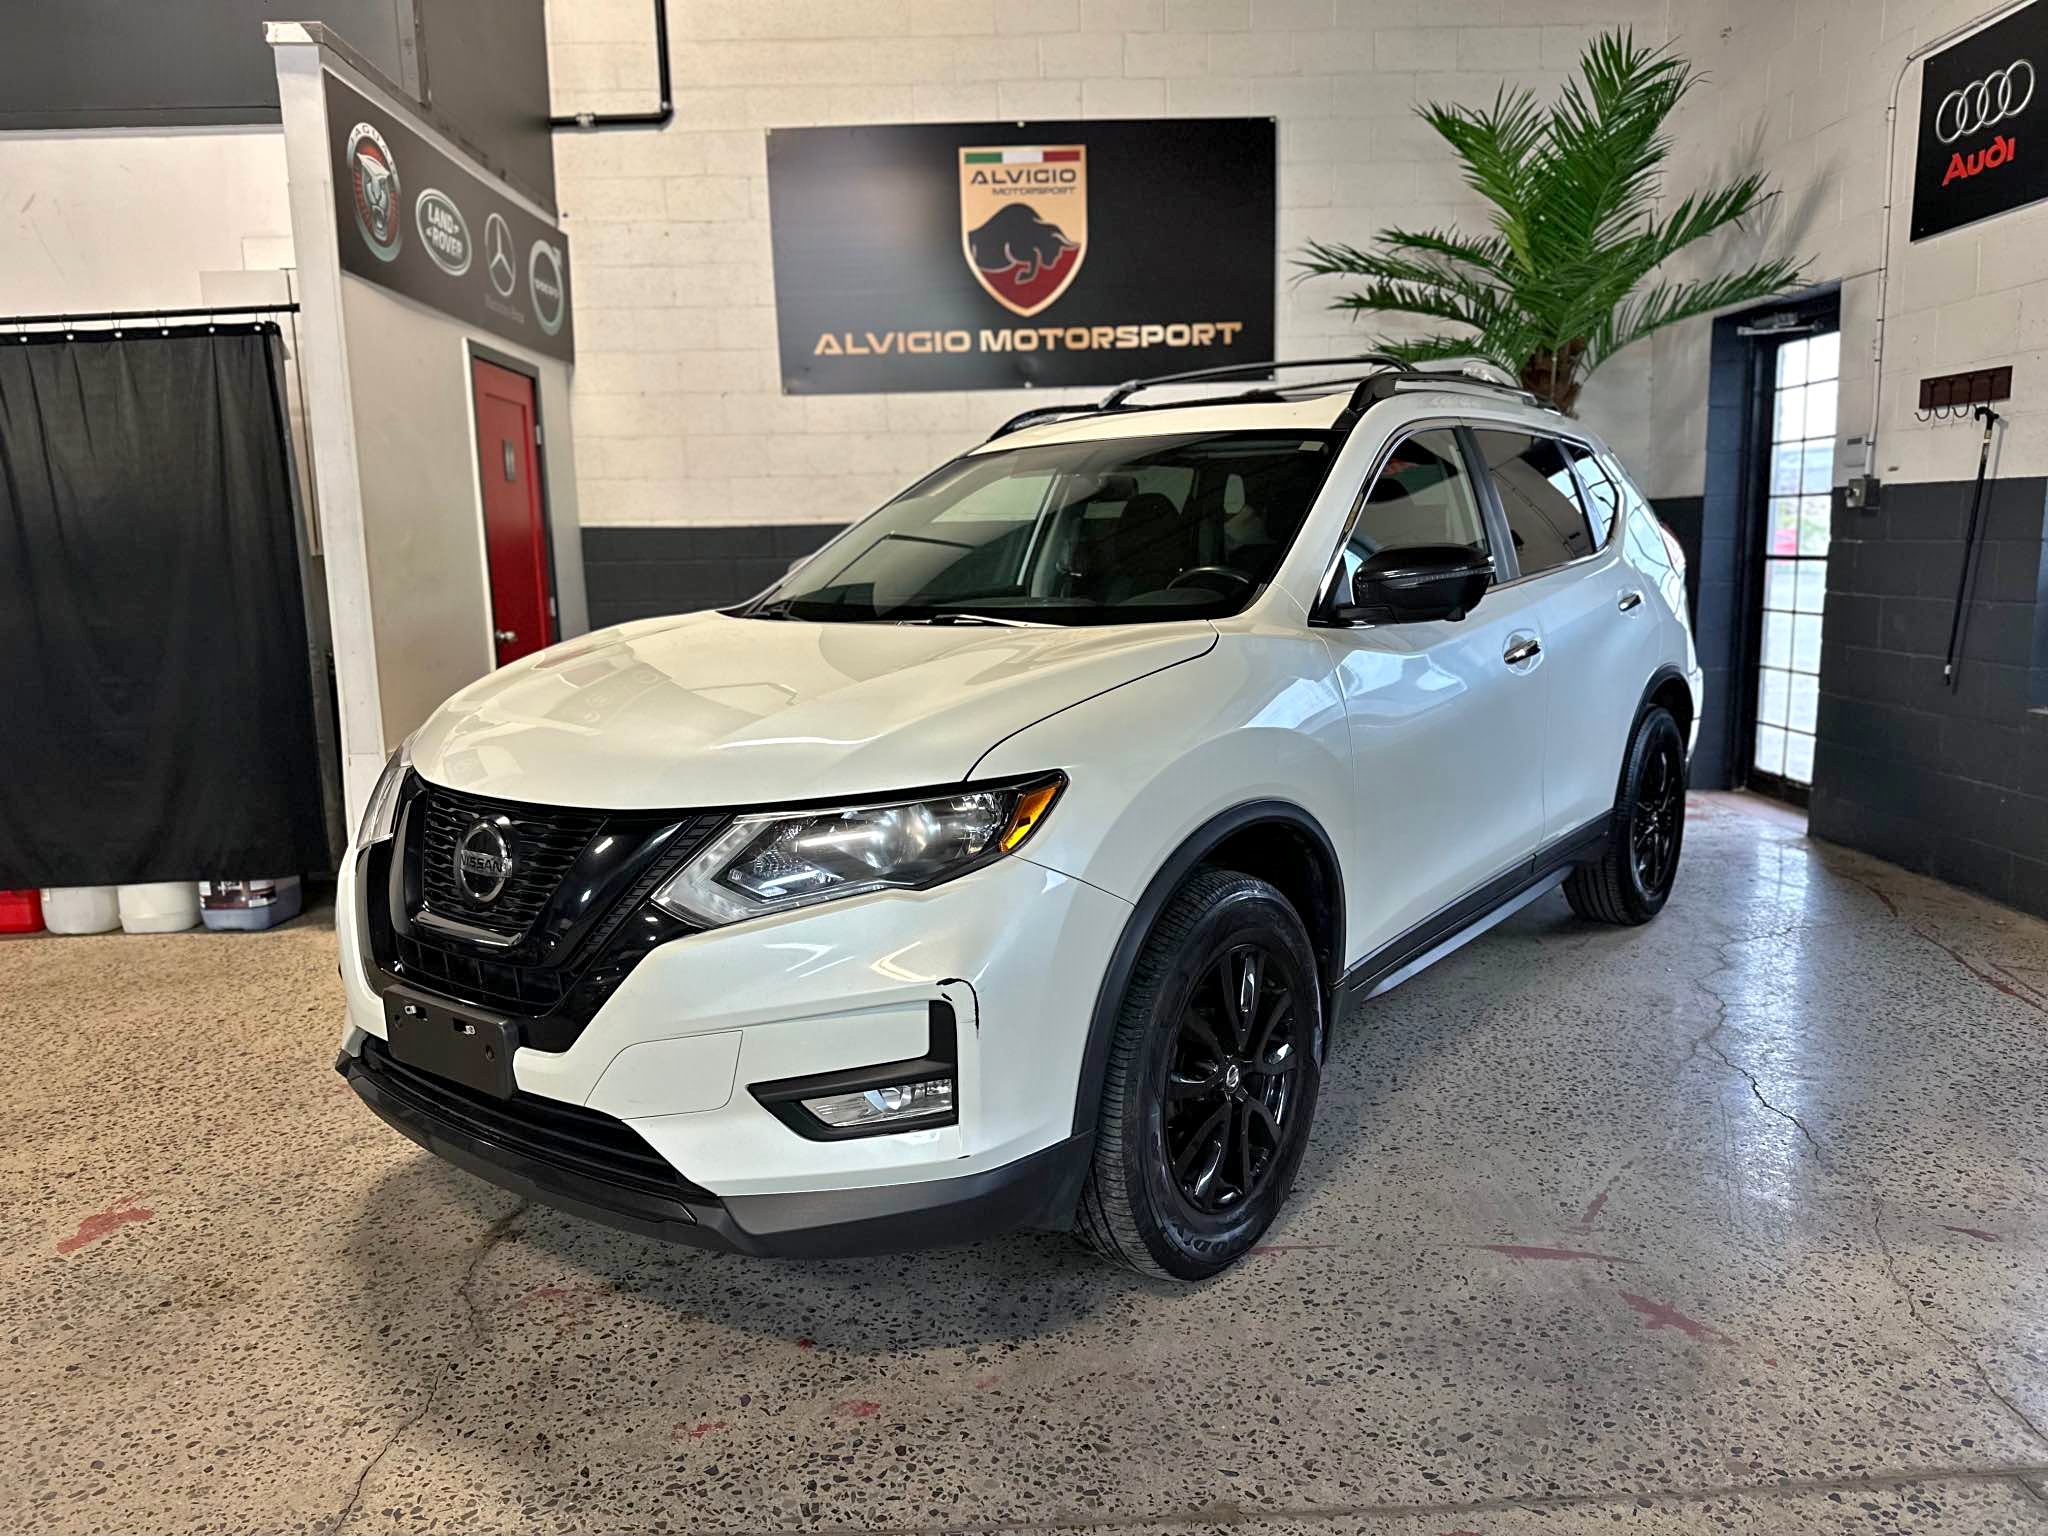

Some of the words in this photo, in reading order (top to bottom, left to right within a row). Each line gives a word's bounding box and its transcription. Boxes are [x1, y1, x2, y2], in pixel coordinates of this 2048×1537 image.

[971, 168, 1077, 185] ALVIGIO
[1942, 135, 2016, 187] Audi
[991, 186, 1077, 196] MOTORSPORT
[428, 202, 454, 235] LAND
[432, 225, 463, 259] ROVER
[814, 331, 971, 356] ALVIGIO
[979, 321, 1242, 353] MOTORSPORT
[461, 853, 503, 873] NISSAN
